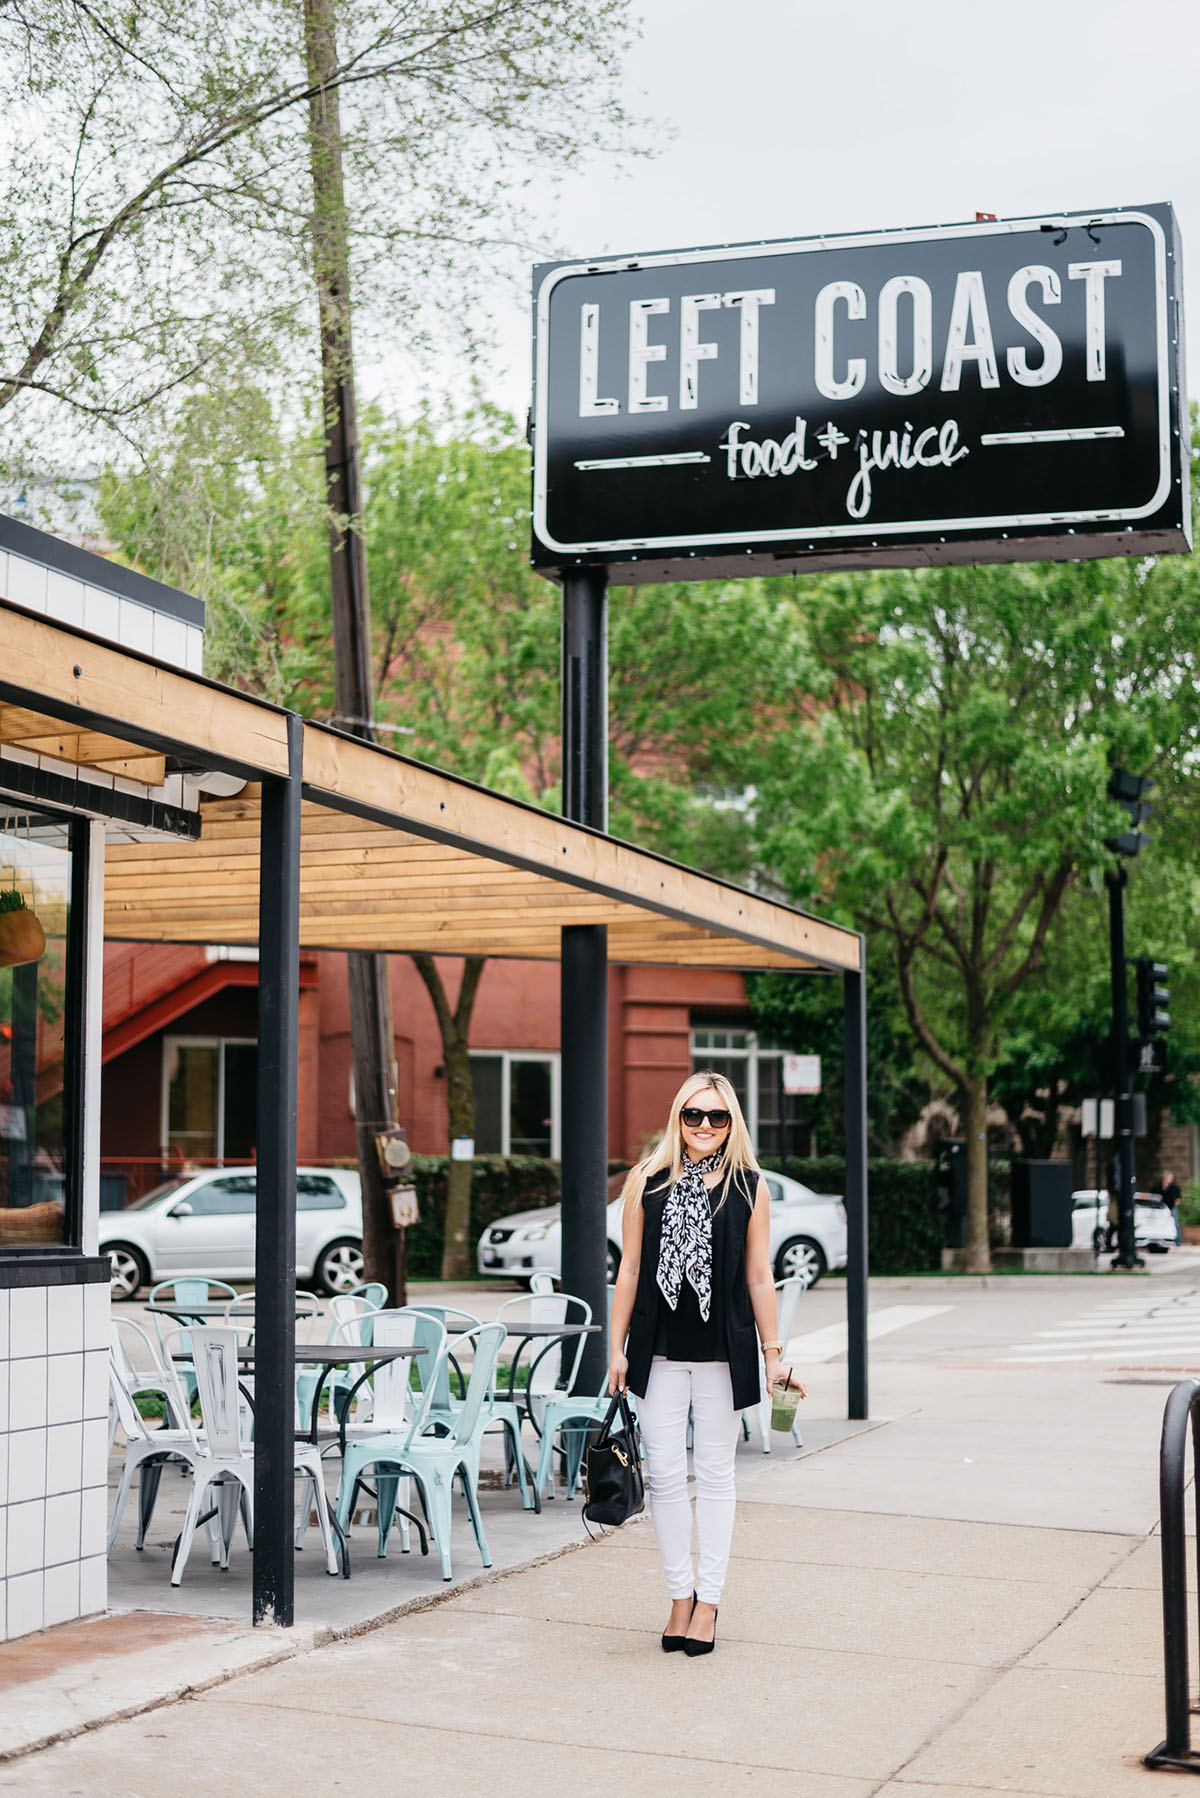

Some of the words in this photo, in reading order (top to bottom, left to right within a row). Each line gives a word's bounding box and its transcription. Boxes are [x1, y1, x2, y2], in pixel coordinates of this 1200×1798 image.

[579, 288, 776, 417] LEFT
[814, 259, 1122, 401] COAST
[719, 416, 818, 480] food
[846, 420, 969, 519] juice
